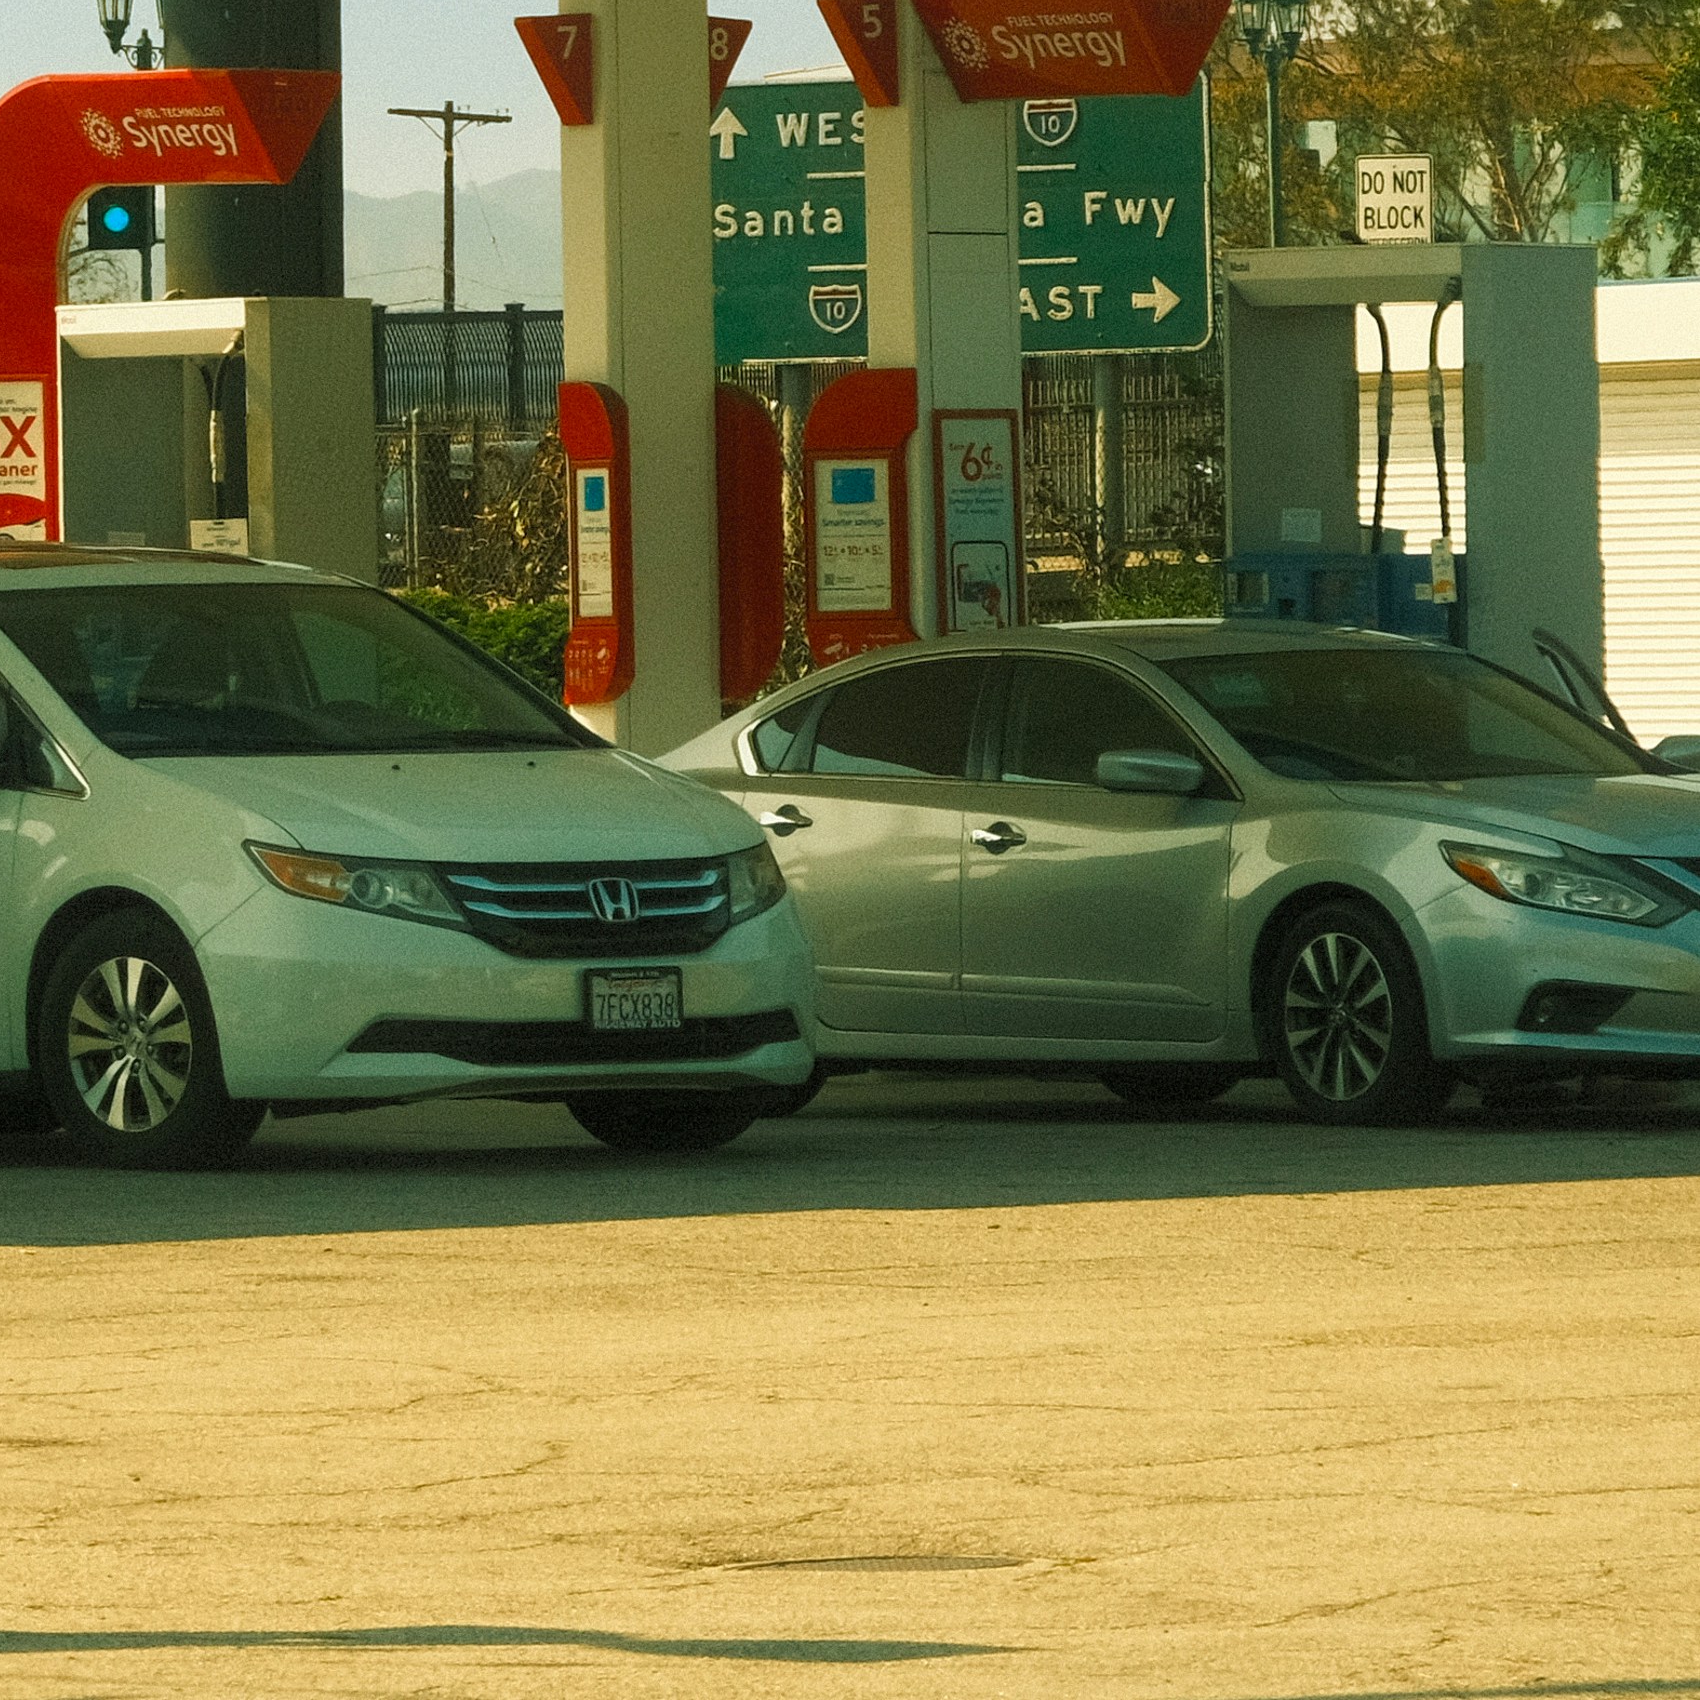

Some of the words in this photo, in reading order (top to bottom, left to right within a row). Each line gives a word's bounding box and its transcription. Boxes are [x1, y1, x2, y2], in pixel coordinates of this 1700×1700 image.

[862, 3, 884, 39] 5
[1006, 15, 1037, 27] FUEL
[1037, 12, 1113, 26] TECHNOLOGY
[556, 24, 579, 61] 7
[709, 27, 729, 61] 8
[991, 25, 1126, 70] Synergy
[121, 116, 239, 157] Synergy
[775, 110, 865, 148] WES
[1040, 114, 1061, 134] 10
[1361, 170, 1385, 195] DO
[1392, 169, 1428, 194] NOT
[712, 200, 844, 238] Santa
[1083, 190, 1176, 239] Fwy
[1363, 204, 1425, 230] BLOCK
[825, 301, 846, 321] 10
[1018, 284, 1103, 321] AST
